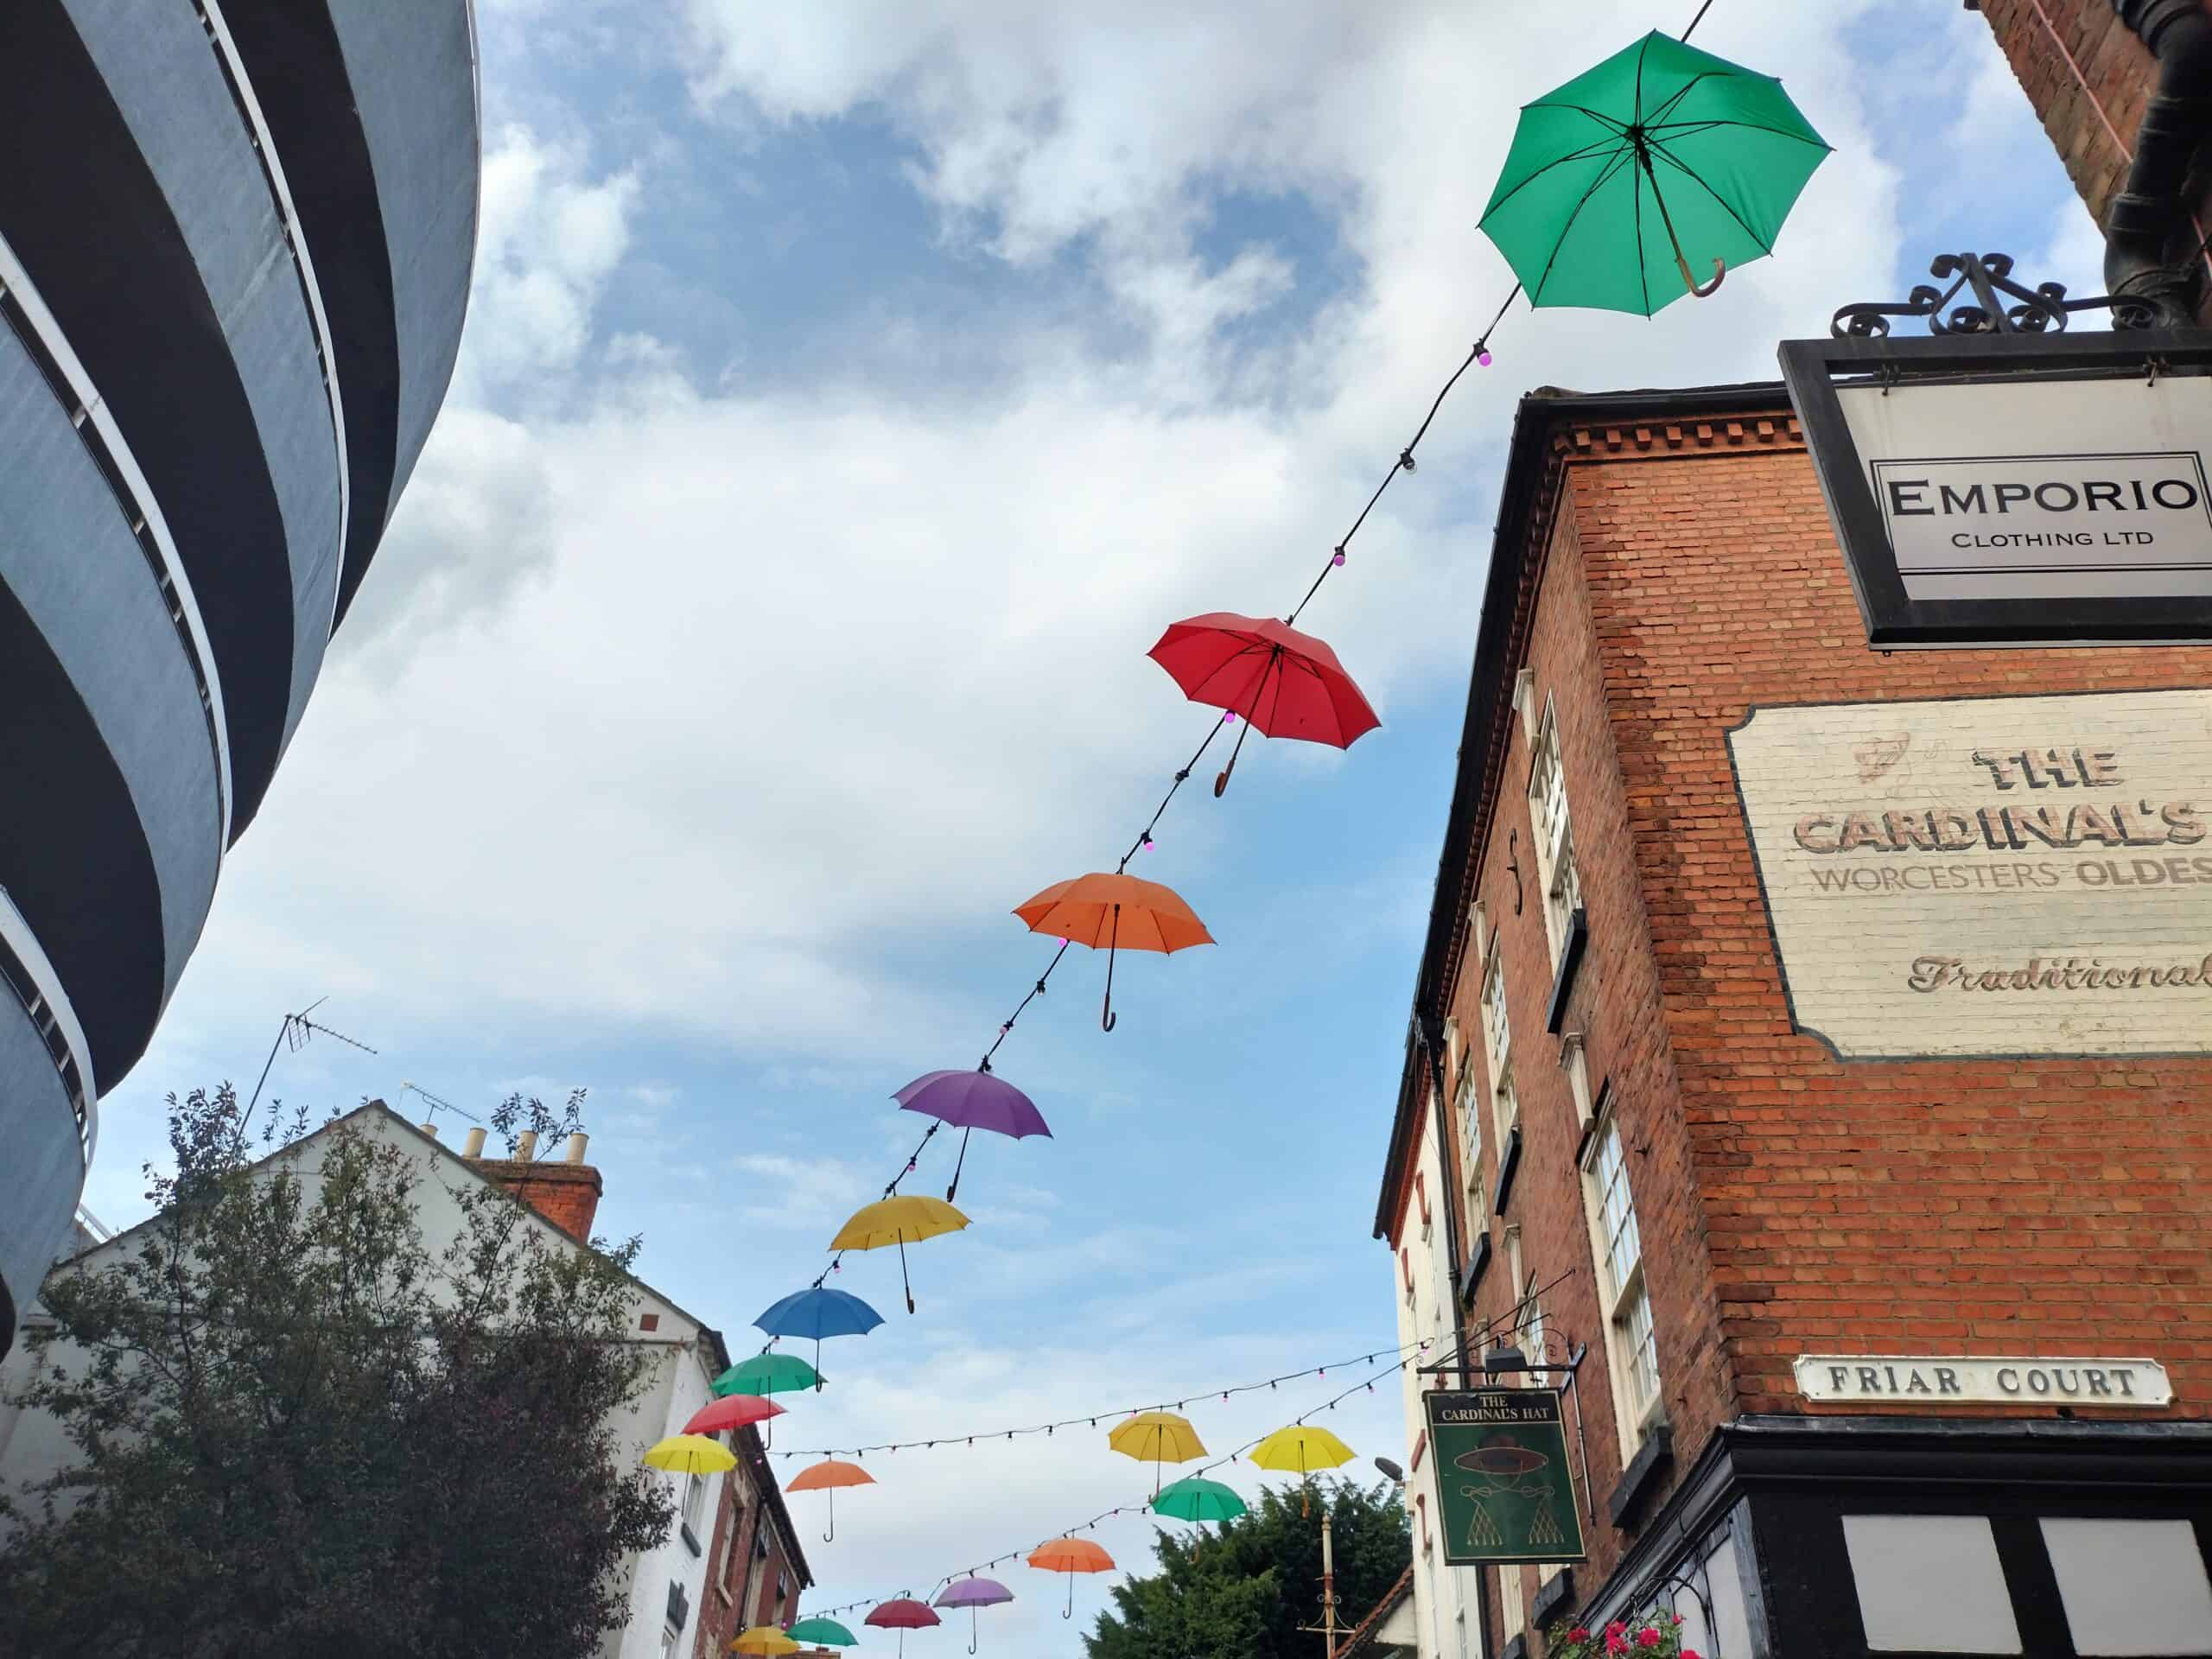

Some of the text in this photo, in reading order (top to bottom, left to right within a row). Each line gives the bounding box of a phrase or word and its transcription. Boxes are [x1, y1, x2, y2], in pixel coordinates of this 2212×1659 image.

[1887, 479, 2198, 517] EMPORIO
[1951, 531, 2154, 549] CLOTHING LTD
[1972, 746, 2123, 791] THE
[1793, 798, 2207, 854] CARDINAL'S
[1812, 861, 2060, 892] WORCESTERS
[1827, 1365, 2135, 1396] FRIAR COURT
[1441, 1408, 1549, 1421] CARDINAL'S HAT
[1479, 1395, 1508, 1408] THE
